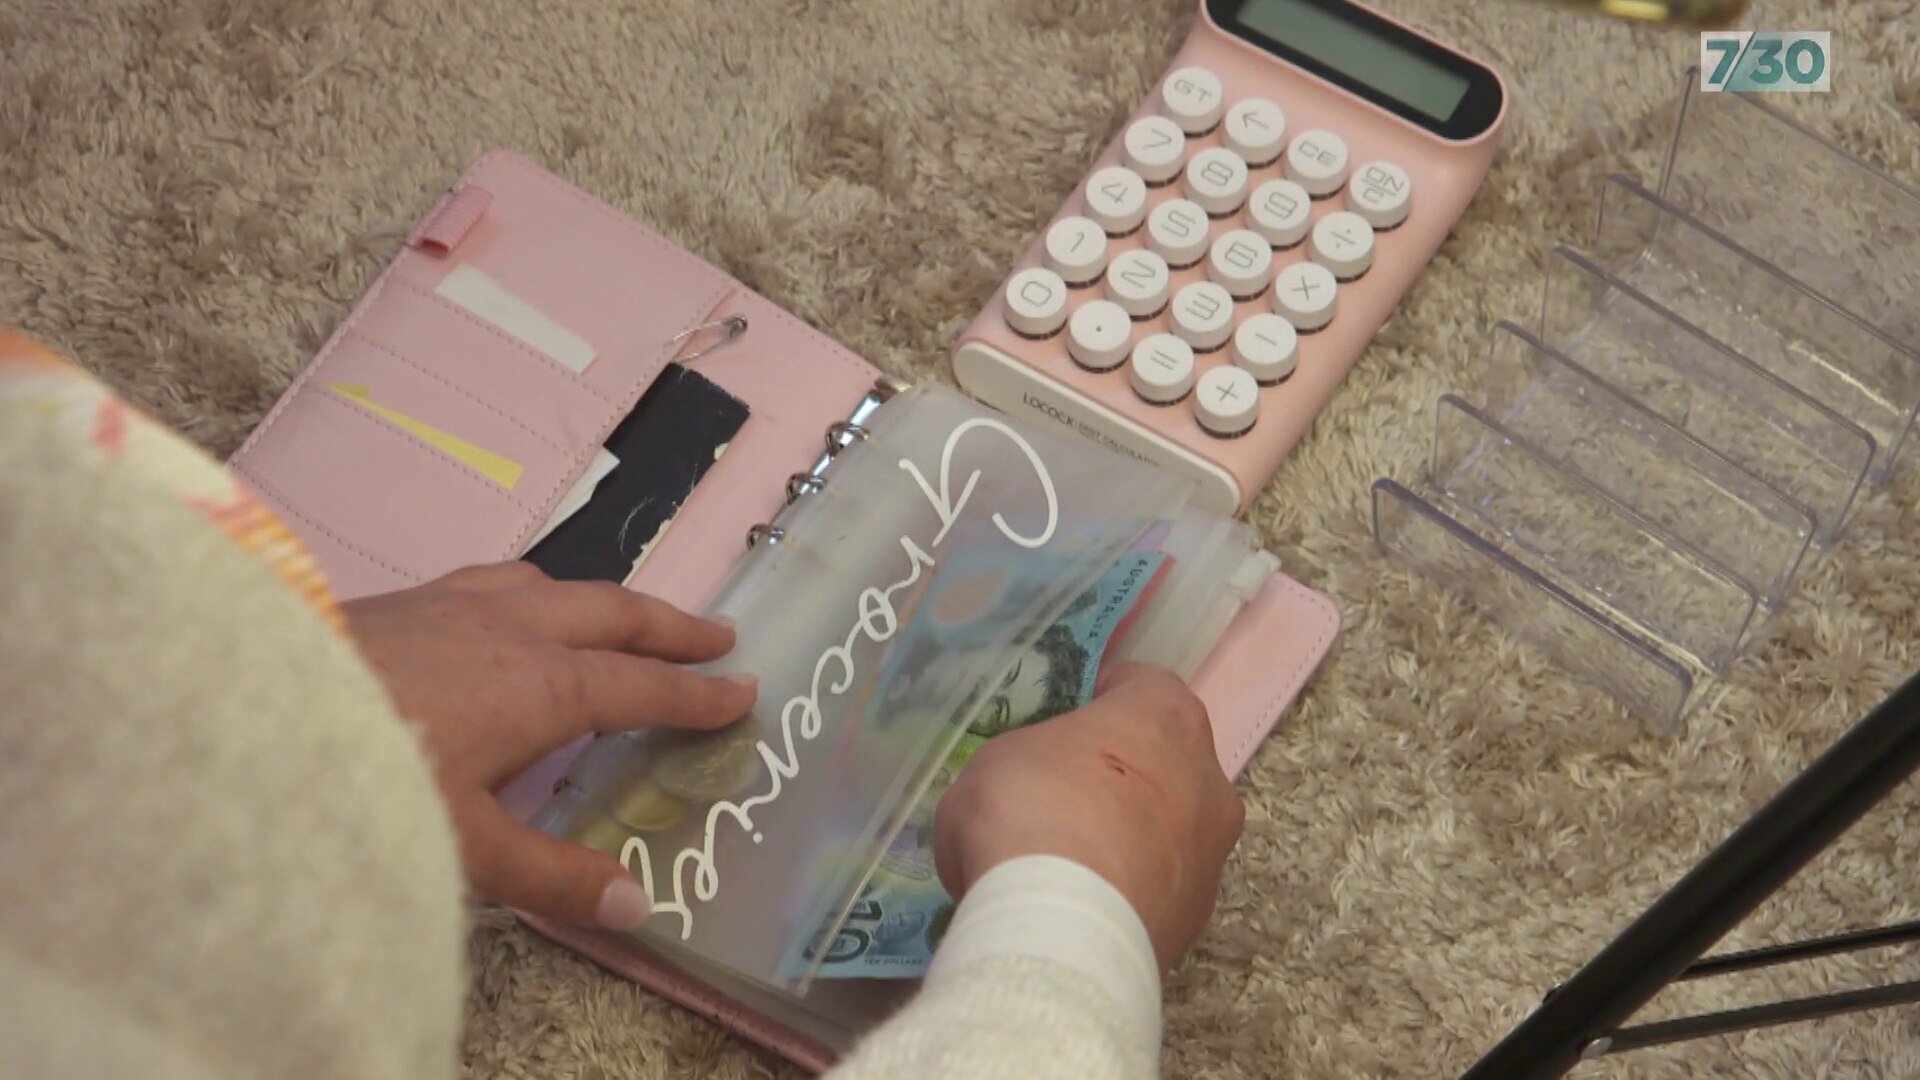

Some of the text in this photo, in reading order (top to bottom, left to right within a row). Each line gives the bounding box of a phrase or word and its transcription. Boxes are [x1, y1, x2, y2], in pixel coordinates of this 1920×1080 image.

[1174, 78, 1213, 102] GT
[1142, 128, 1173, 151] 7
[1298, 141, 1337, 168] CE
[1201, 160, 1235, 188] 8
[1101, 181, 1129, 204] 4
[1263, 191, 1298, 219] 9
[1161, 210, 1196, 238] 5
[1070, 231, 1085, 253] 1
[1224, 241, 1258, 269] 6
[1121, 259, 1157, 289] 2
[1020, 280, 1052, 308] 0
[1185, 292, 1221, 321] 3
[1087, 559, 1148, 640] AUSTRALIA
